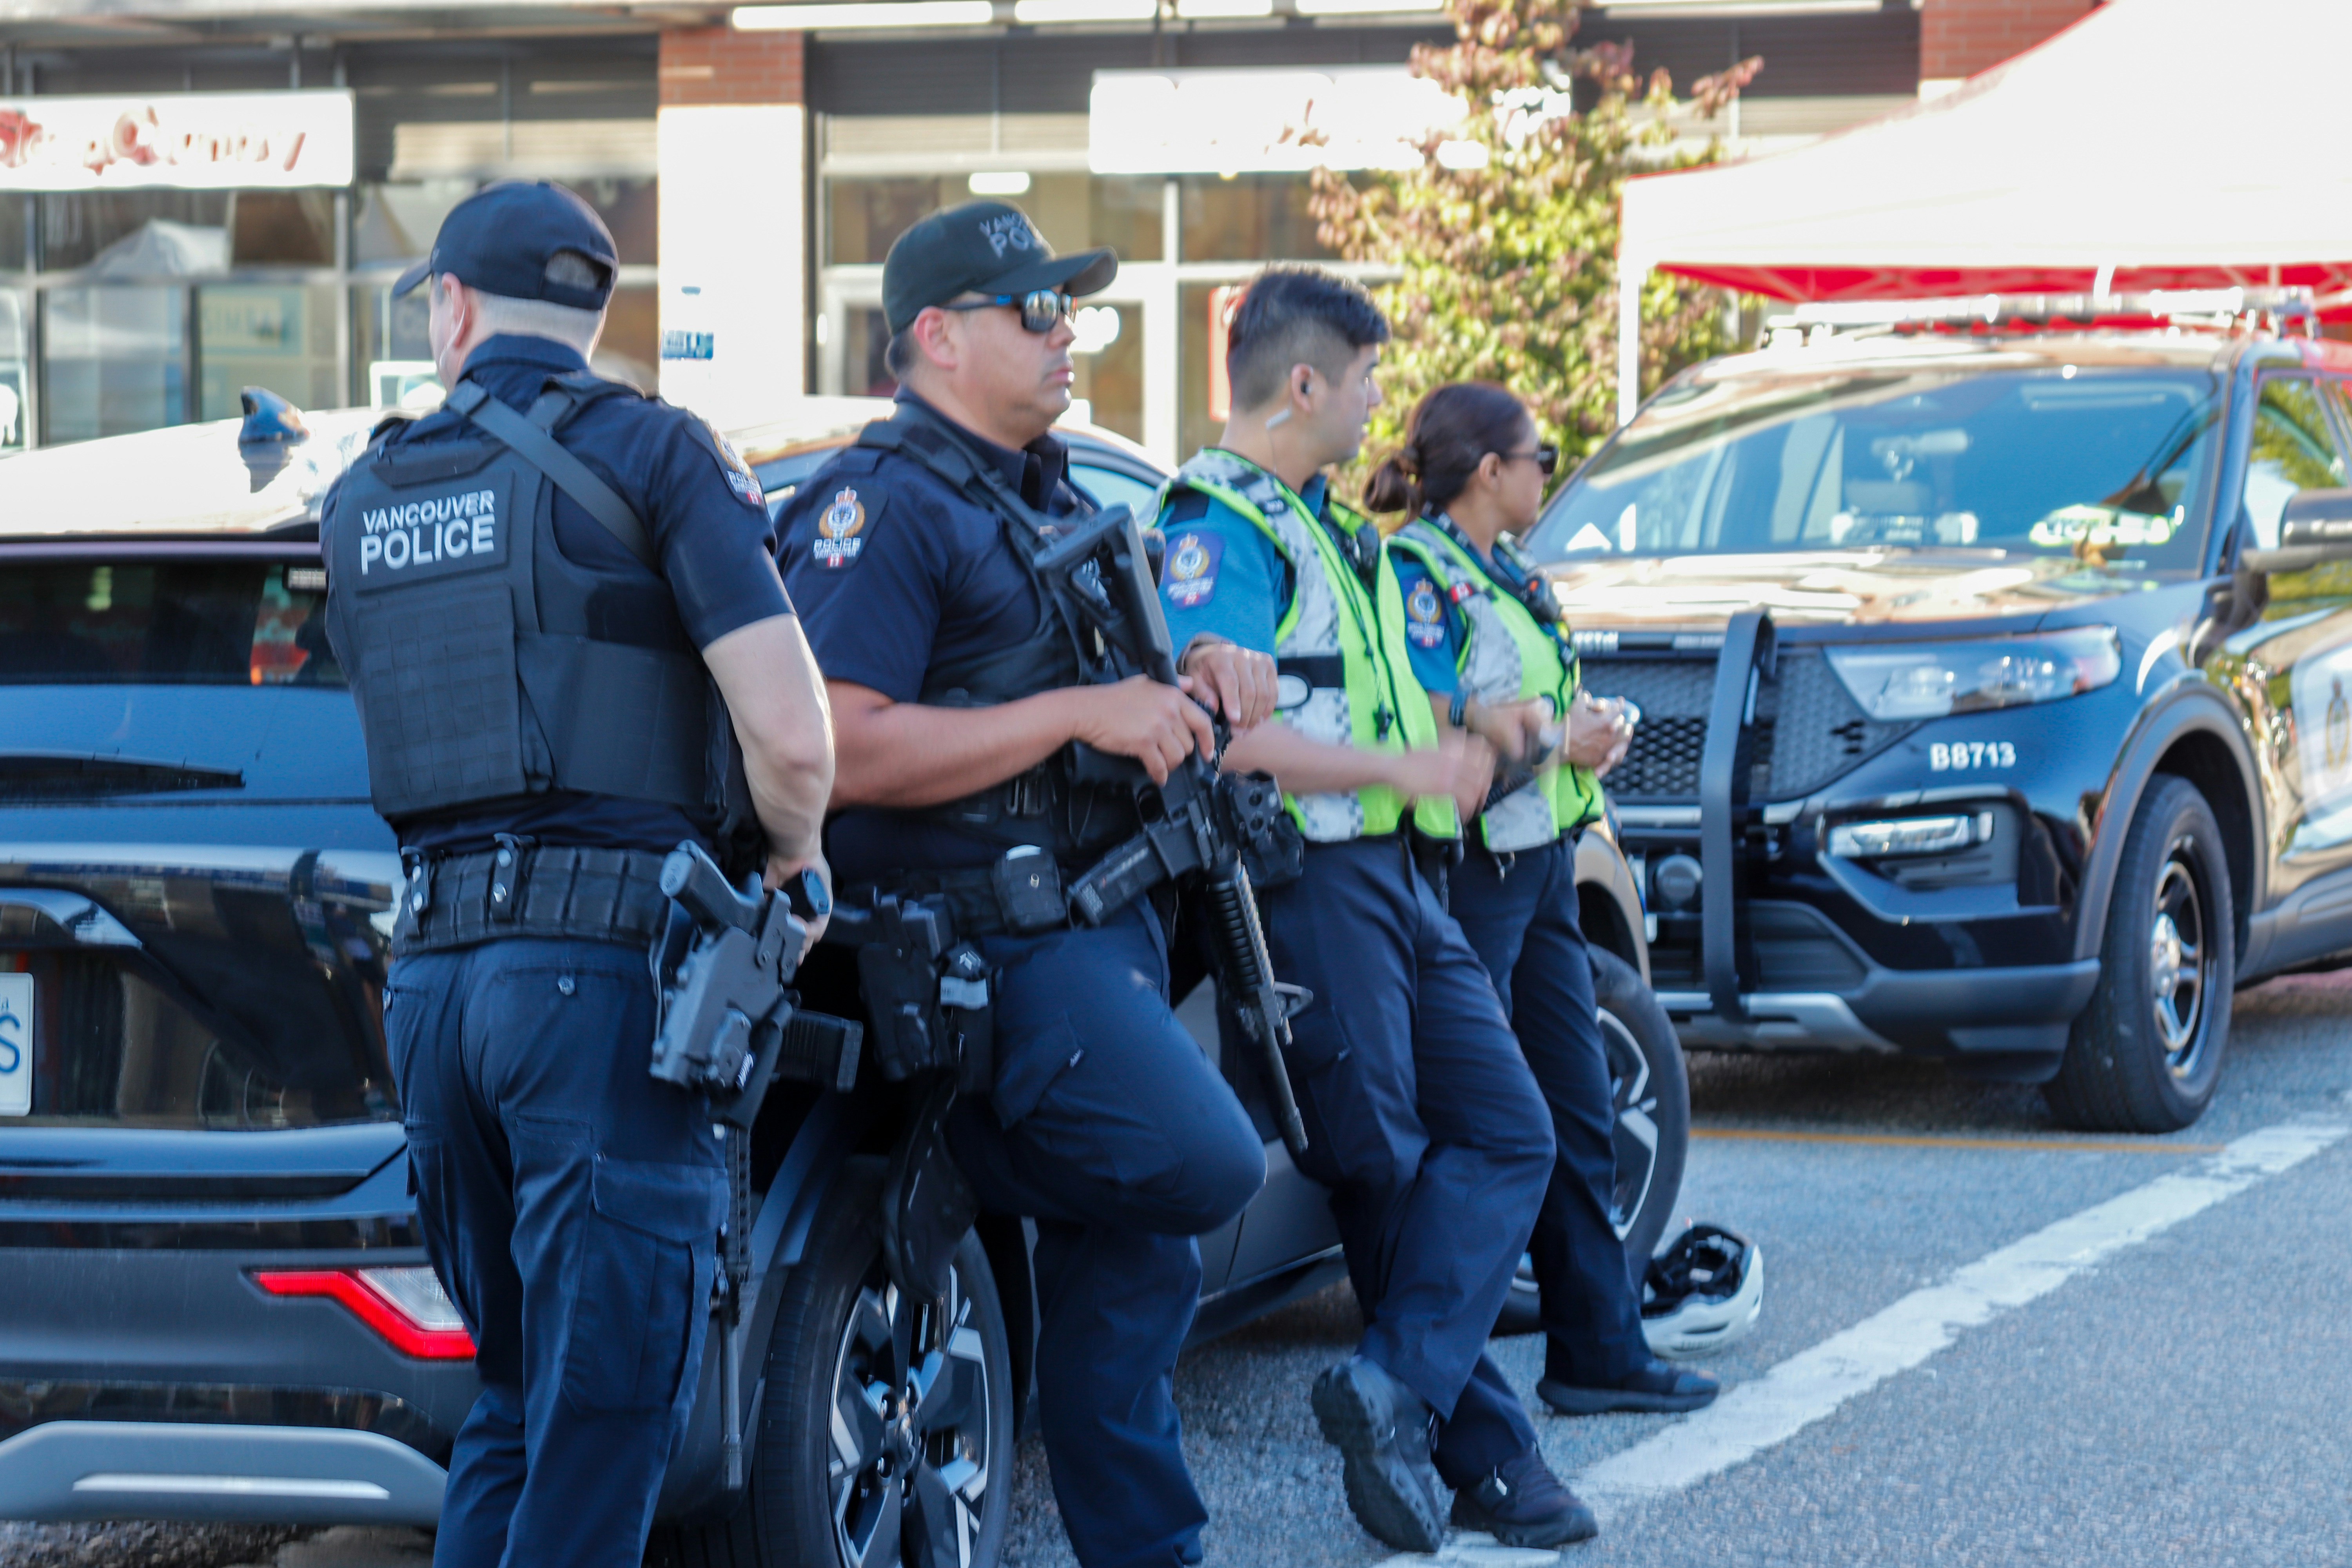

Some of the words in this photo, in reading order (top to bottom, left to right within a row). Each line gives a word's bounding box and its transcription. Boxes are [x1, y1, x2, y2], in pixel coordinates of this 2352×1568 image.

[362, 489, 495, 534] VANCOUVER
[360, 513, 496, 575] POLICE
[813, 537, 861, 553] POLICE
